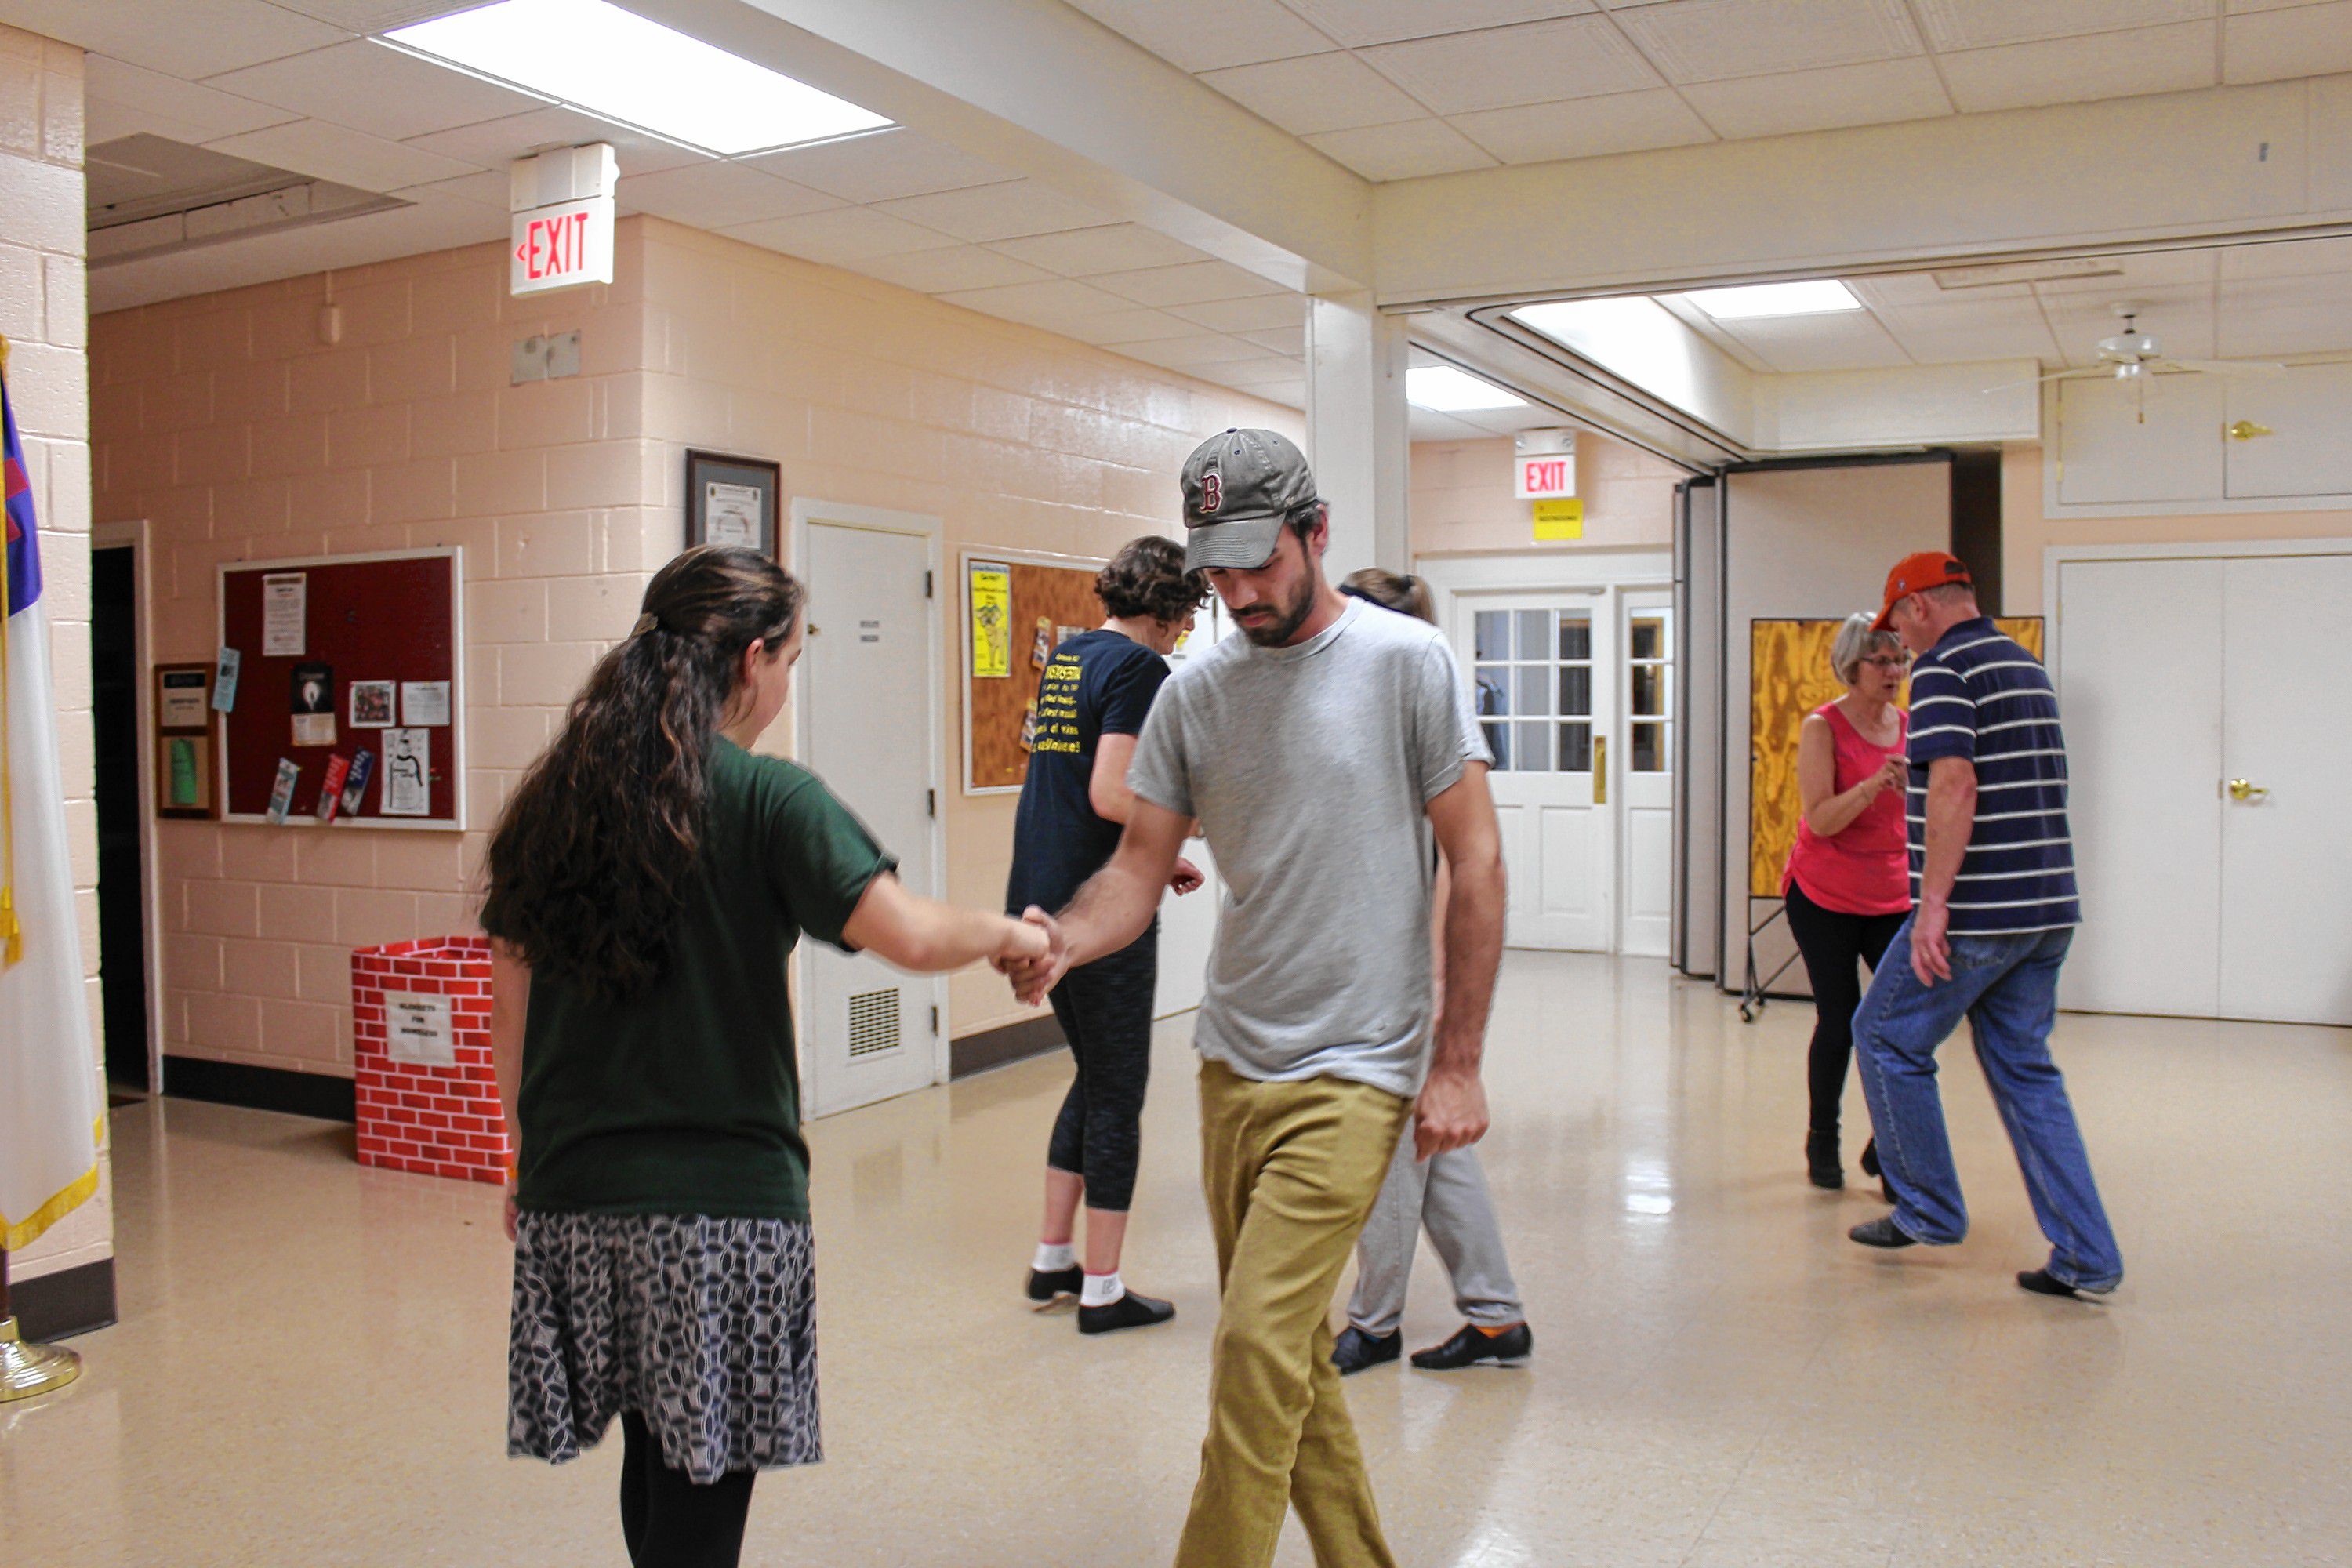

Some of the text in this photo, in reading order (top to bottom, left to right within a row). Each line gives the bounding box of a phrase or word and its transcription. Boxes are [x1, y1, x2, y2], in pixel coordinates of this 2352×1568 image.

[529, 212, 588, 279] EXIT
[1200, 473, 1223, 514] B
[1526, 461, 1566, 492] EXIT
